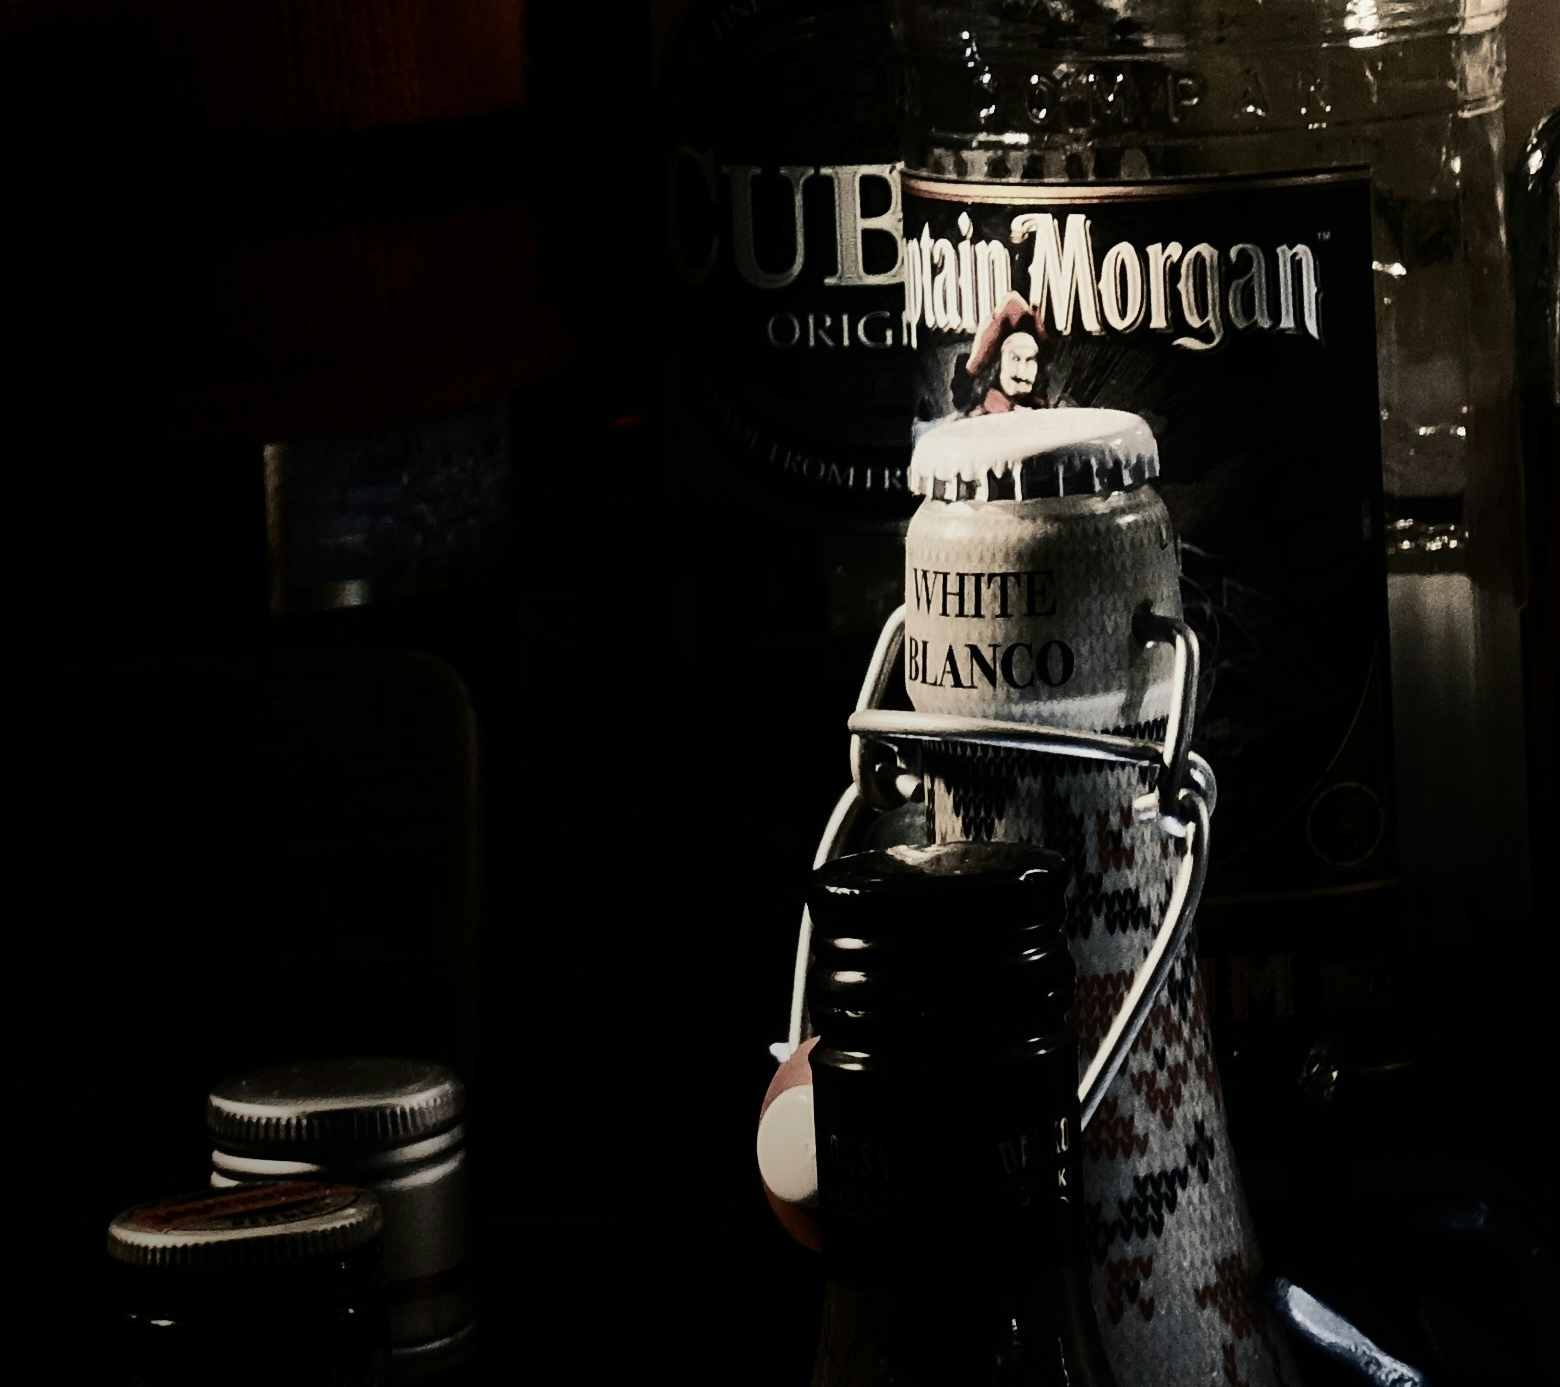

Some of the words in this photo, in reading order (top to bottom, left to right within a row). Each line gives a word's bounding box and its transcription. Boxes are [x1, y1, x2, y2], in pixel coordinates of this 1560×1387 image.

[1012, 212, 1330, 353] Morgan
[912, 567, 1058, 619] WHITE
[908, 635, 1076, 690] BLANCO
